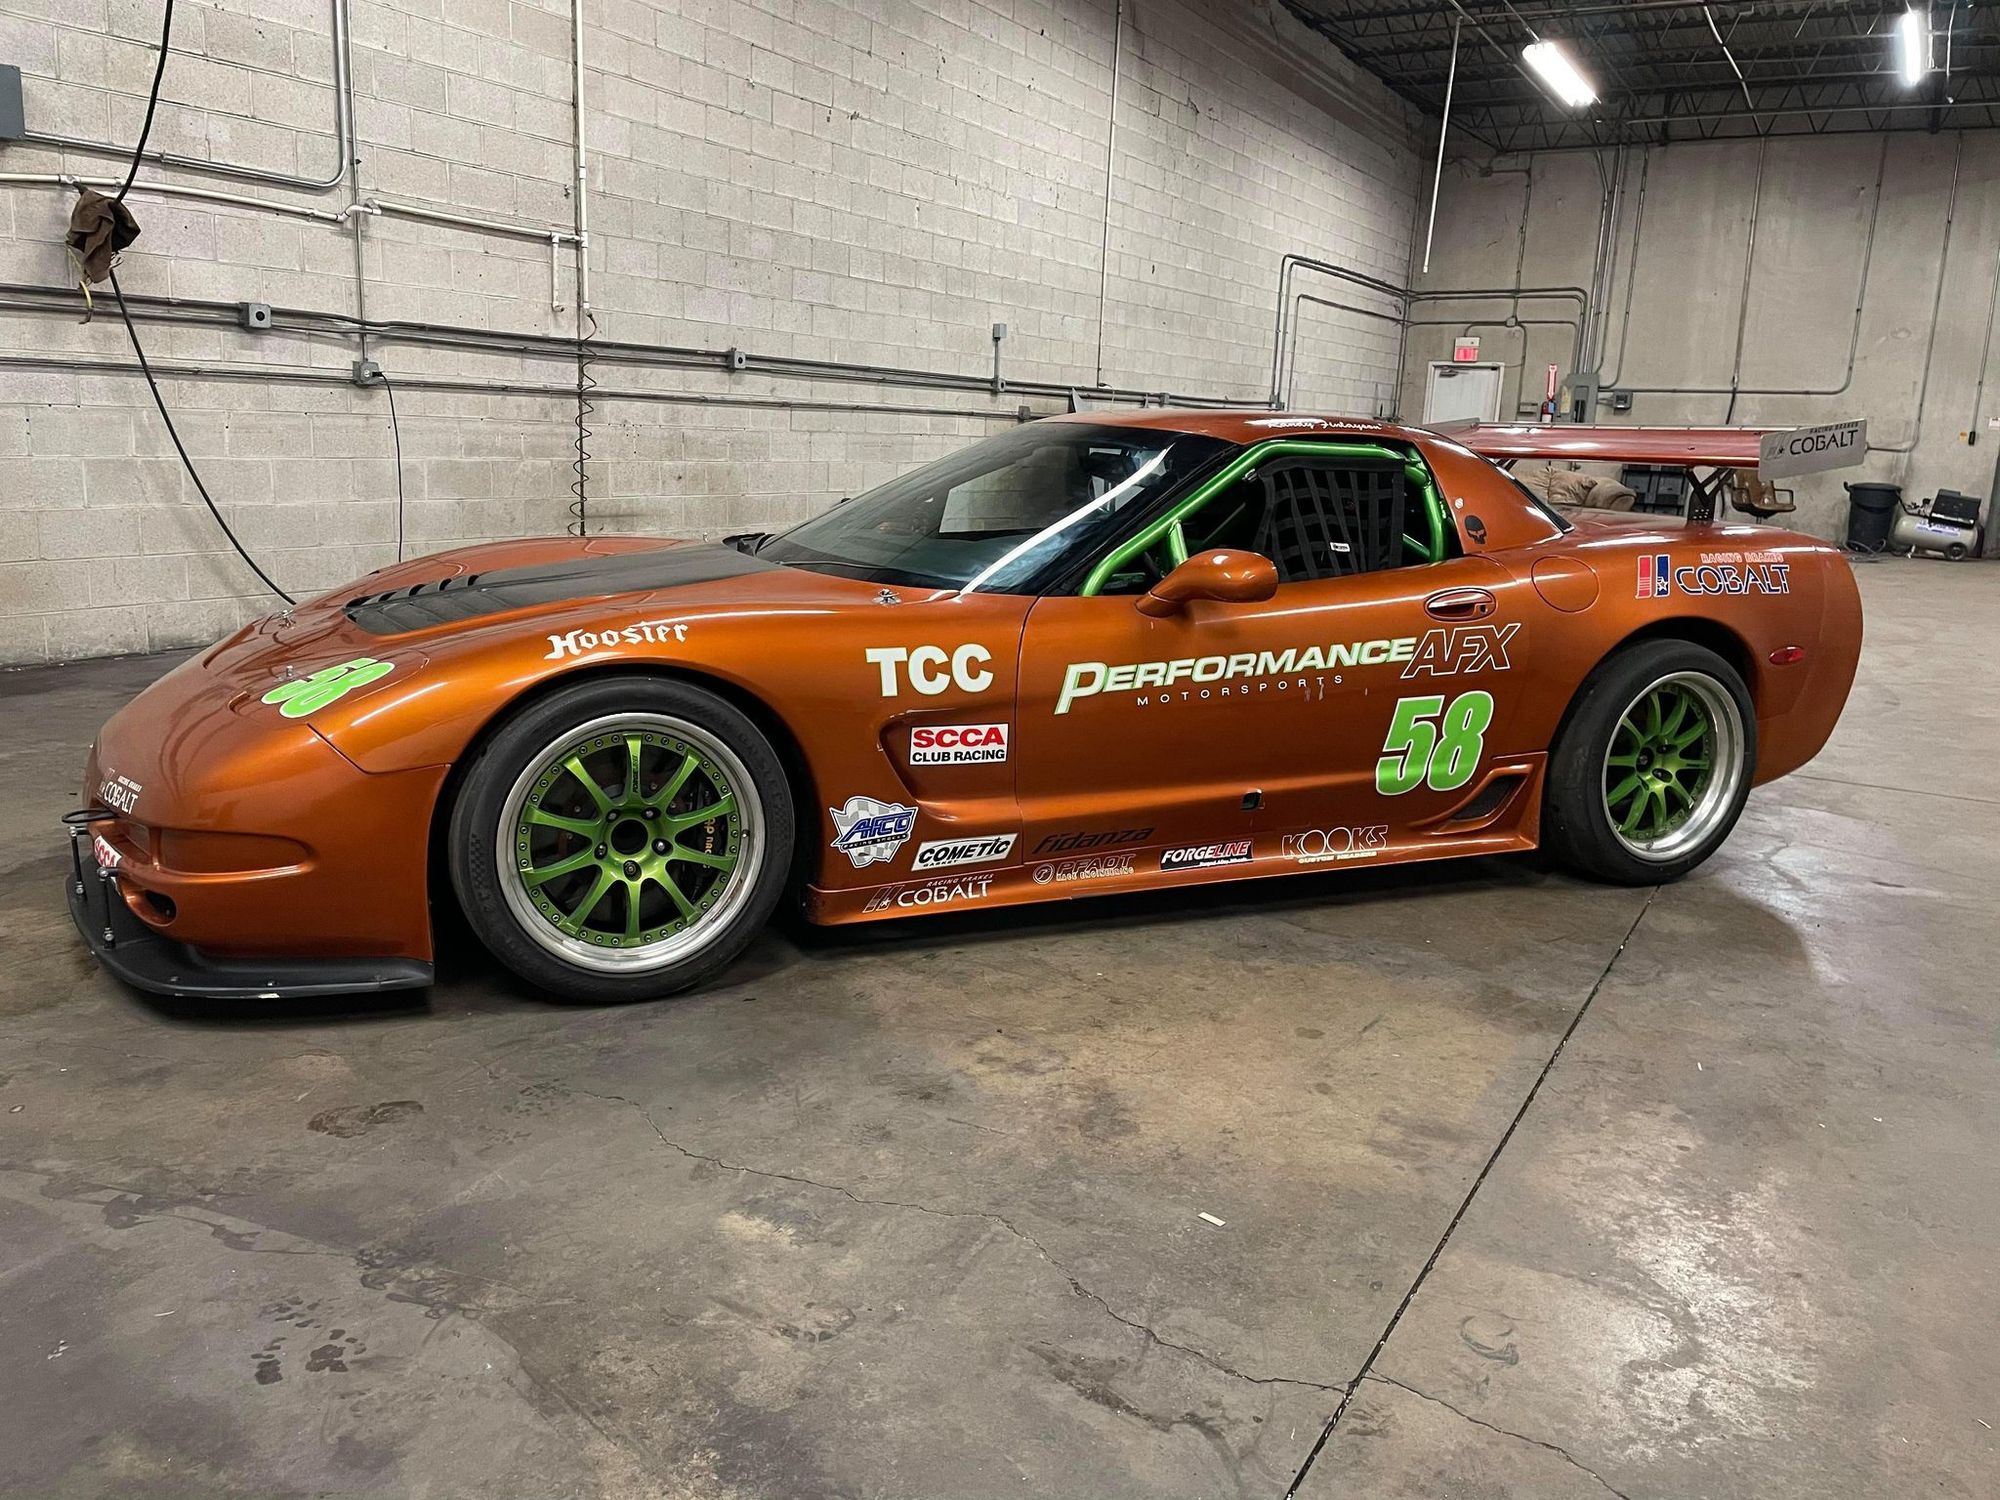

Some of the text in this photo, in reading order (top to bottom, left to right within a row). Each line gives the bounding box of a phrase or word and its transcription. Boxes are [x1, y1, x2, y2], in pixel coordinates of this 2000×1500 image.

[1789, 429, 1859, 455] COBALT
[1674, 564, 1790, 596] COBALT
[543, 620, 689, 660] Hoosier
[865, 643, 994, 697] TCC
[1054, 622, 1521, 715] PERFORMANCE AFX
[261, 657, 396, 718] 58
[1136, 674, 1344, 706] MOTORSPORTS
[912, 726, 1005, 748] SCCA
[1375, 690, 1495, 796] 58
[912, 749, 1005, 763] CLUB RACING
[104, 781, 139, 815] COBALT
[839, 811, 913, 843] AFCO
[1281, 825, 1389, 857] KOOKS
[918, 837, 1011, 864] COMETIC
[1160, 841, 1252, 864] FORGELINE
[897, 880, 993, 907] COBALT
[926, 873, 994, 887] RACING BRAKES
